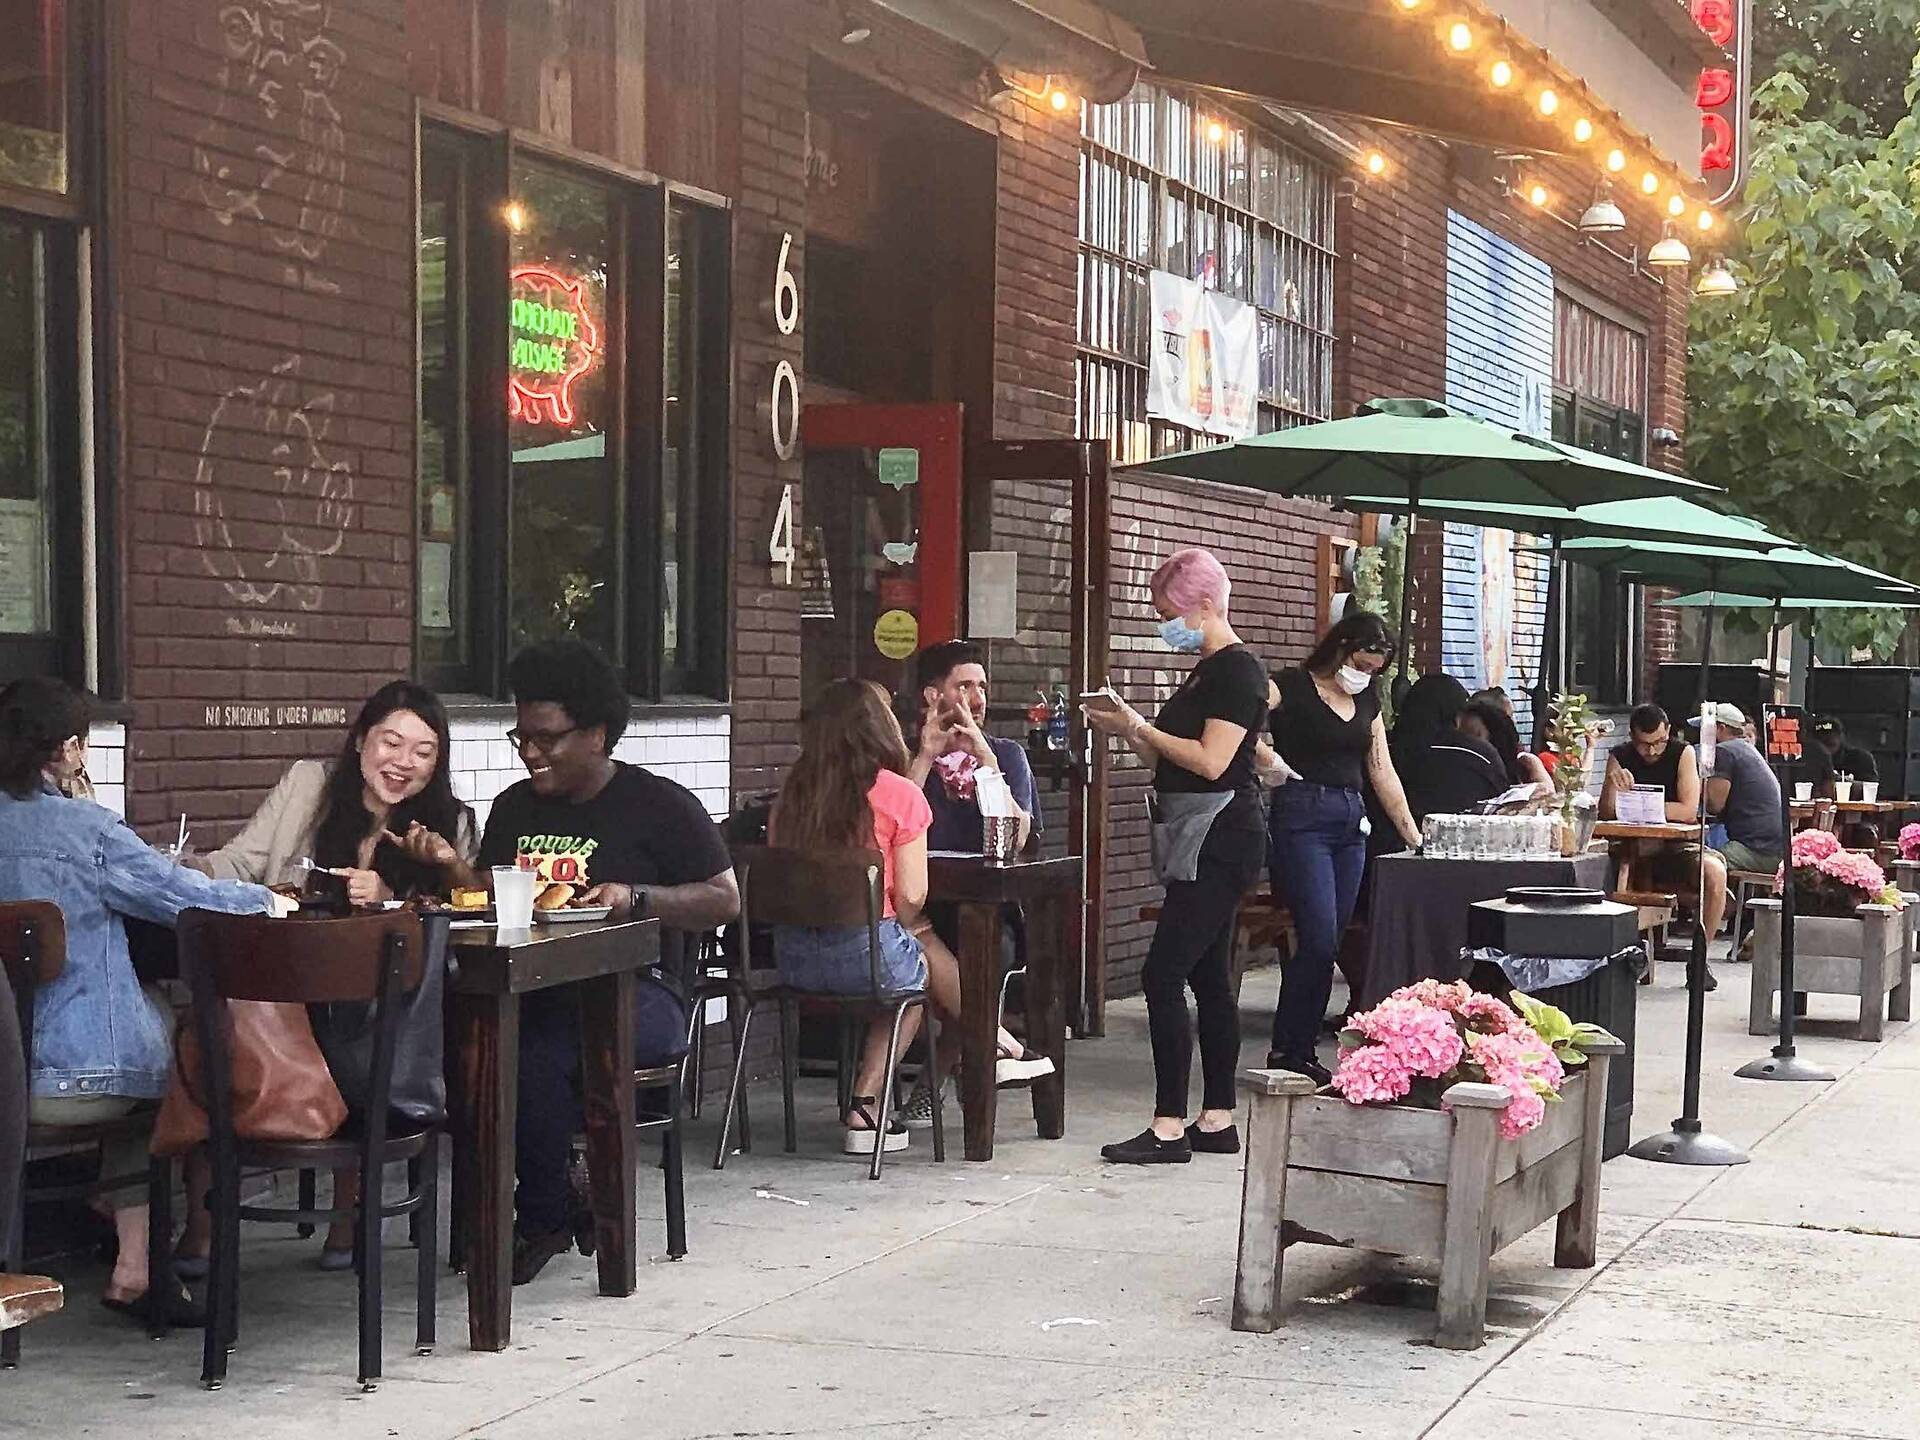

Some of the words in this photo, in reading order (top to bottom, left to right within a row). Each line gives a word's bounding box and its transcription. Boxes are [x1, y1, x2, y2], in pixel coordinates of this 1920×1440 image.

[511, 298, 579, 341] OMEMADE
[511, 338, 567, 374] AUSAGE
[770, 232, 800, 585] 604
[205, 707, 221, 726] NO
[225, 706, 270, 727] SMOKING
[276, 706, 308, 726] UNDER
[517, 835, 599, 855] DOUBLE
